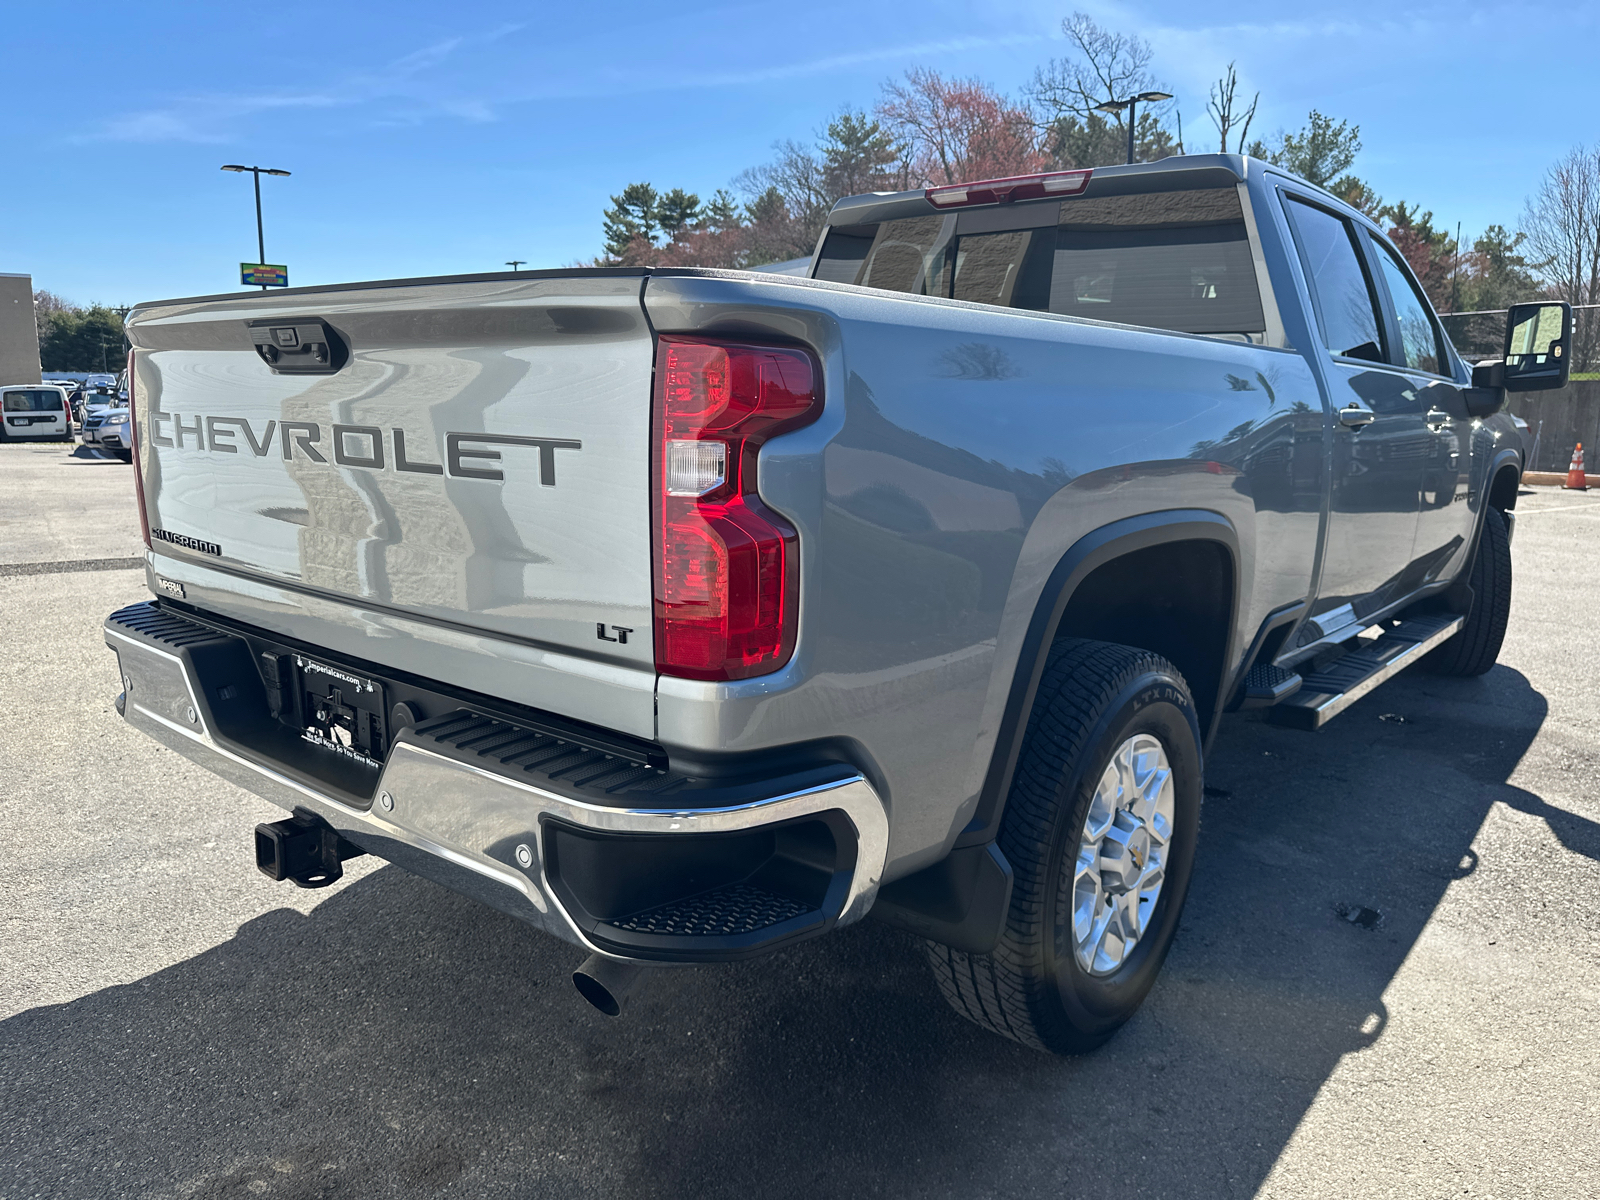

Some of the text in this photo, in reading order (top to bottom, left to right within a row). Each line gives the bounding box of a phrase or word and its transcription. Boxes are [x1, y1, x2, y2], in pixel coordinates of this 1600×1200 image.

[150, 411, 582, 486] CHEVROLET
[152, 528, 222, 556] SILVERADO
[597, 622, 634, 644] LT
[1132, 688, 1160, 711] LTX
